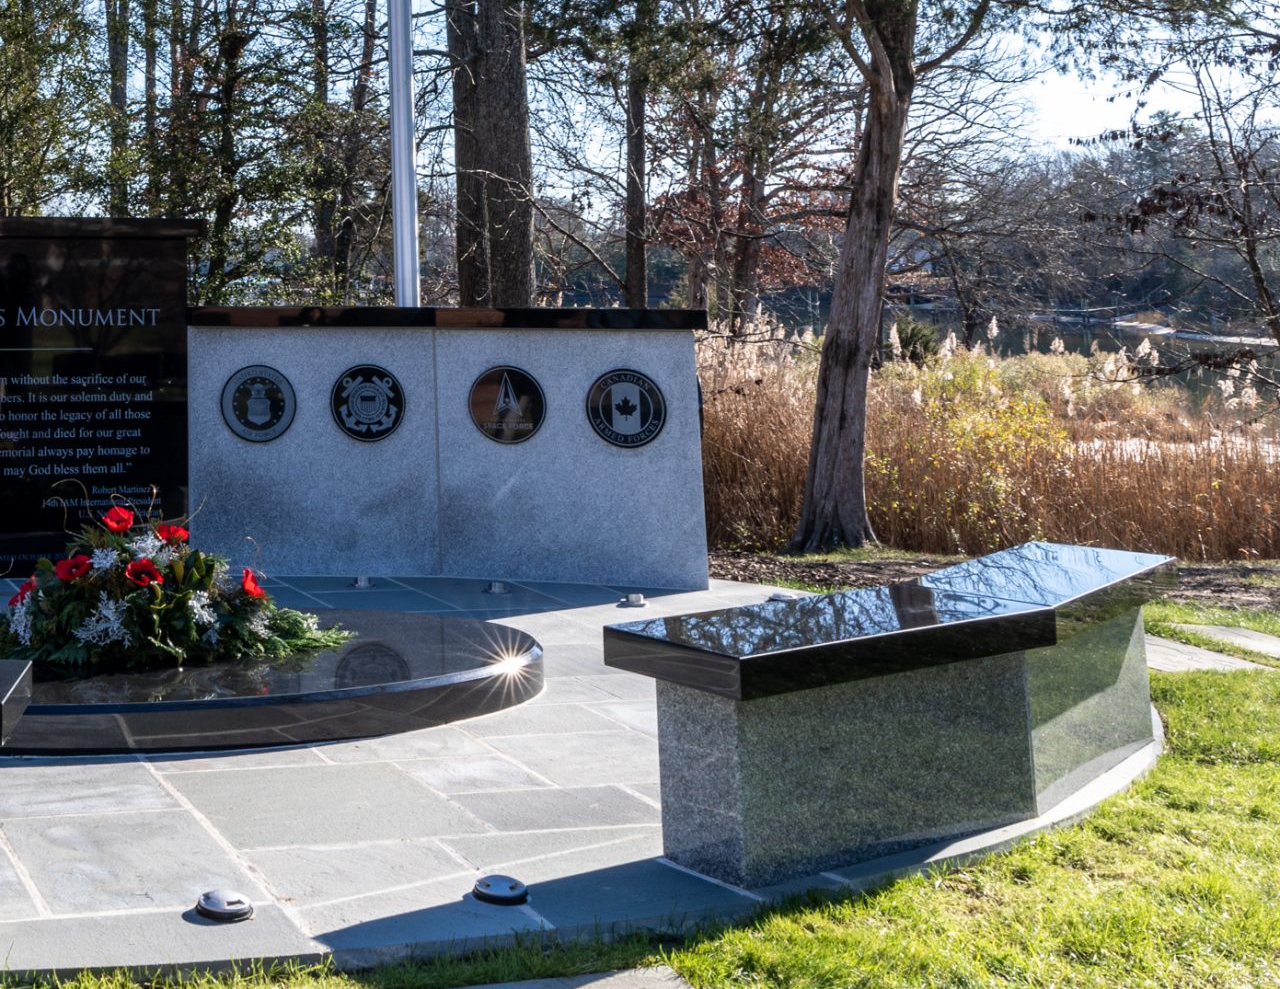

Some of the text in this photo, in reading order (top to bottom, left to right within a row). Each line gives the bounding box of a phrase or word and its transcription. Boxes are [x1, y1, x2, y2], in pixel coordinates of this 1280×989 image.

[11, 374, 49, 385] without
[52, 373, 68, 384] the
[71, 373, 113, 384] sacrifice
[116, 373, 128, 384] of
[129, 375, 147, 384] our
[600, 374, 651, 390] CANADIAN
[28, 392, 36, 402] It
[39, 392, 48, 402] is
[50, 394, 67, 402] our
[70, 391, 107, 402] solemn
[109, 391, 132, 404] duty
[134, 390, 153, 401] and
[8, 410, 38, 421] honor
[41, 409, 57, 420] the
[60, 409, 93, 422] legacy
[95, 408, 108, 419] of
[109, 408, 122, 419] all
[124, 408, 151, 419] those
[32, 428, 51, 438] and
[54, 427, 76, 438] died
[79, 427, 94, 438] for
[96, 429, 114, 438] our
[116, 428, 141, 440] great
[594, 418, 659, 444] ARMED FORCES
[37, 445, 74, 459] always
[76, 448, 95, 459] pay
[97, 445, 137, 457] homage
[140, 446, 151, 455] to
[3, 467, 25, 479] may
[28, 463, 51, 475] God
[54, 463, 80, 474] bless
[82, 463, 108, 474] them
[91, 485, 117, 495] Robert
[118, 484, 151, 494] Martinez
